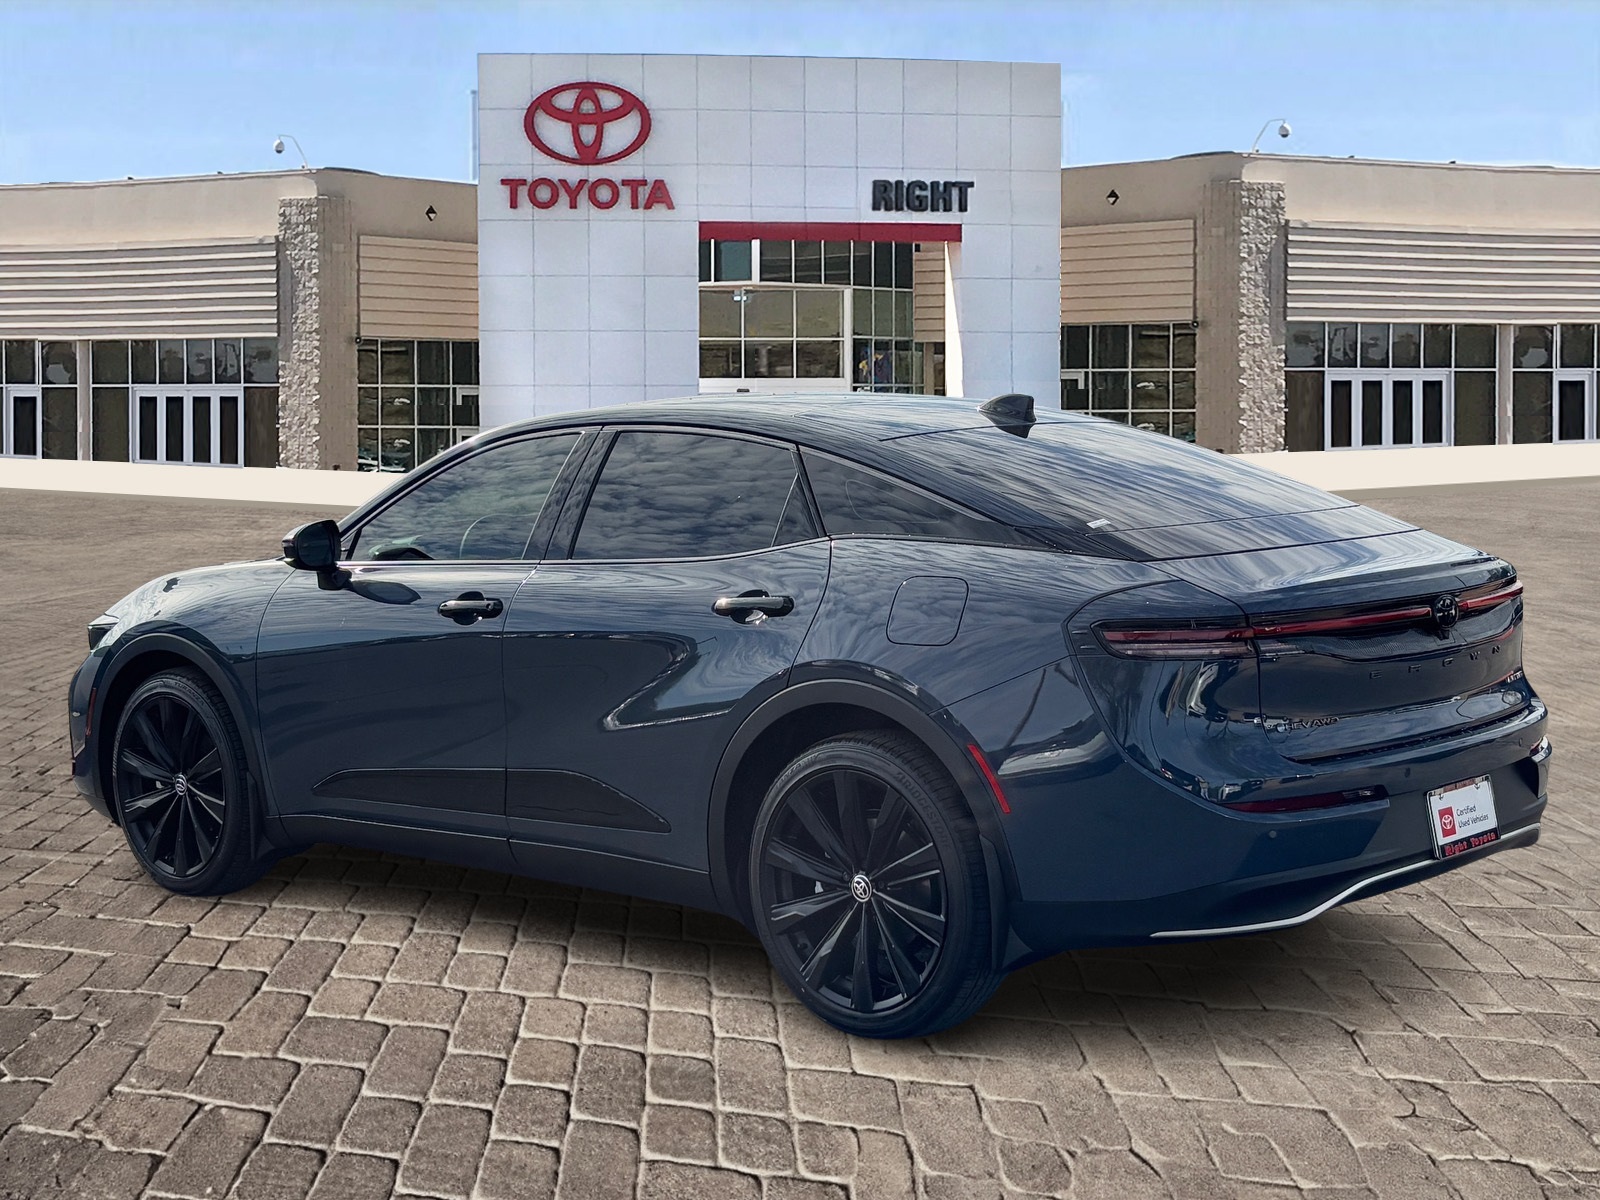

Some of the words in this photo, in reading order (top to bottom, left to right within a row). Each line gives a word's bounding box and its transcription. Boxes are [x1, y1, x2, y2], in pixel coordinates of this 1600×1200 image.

[500, 178, 675, 210] TOYOTA
[872, 179, 975, 213] RIGHT
[1456, 804, 1476, 817] Certified
[1458, 817, 1470, 828] Used
[1470, 813, 1489, 825] Vehicles
[1444, 841, 1468, 855] Right
[1471, 832, 1496, 847] Toyota
